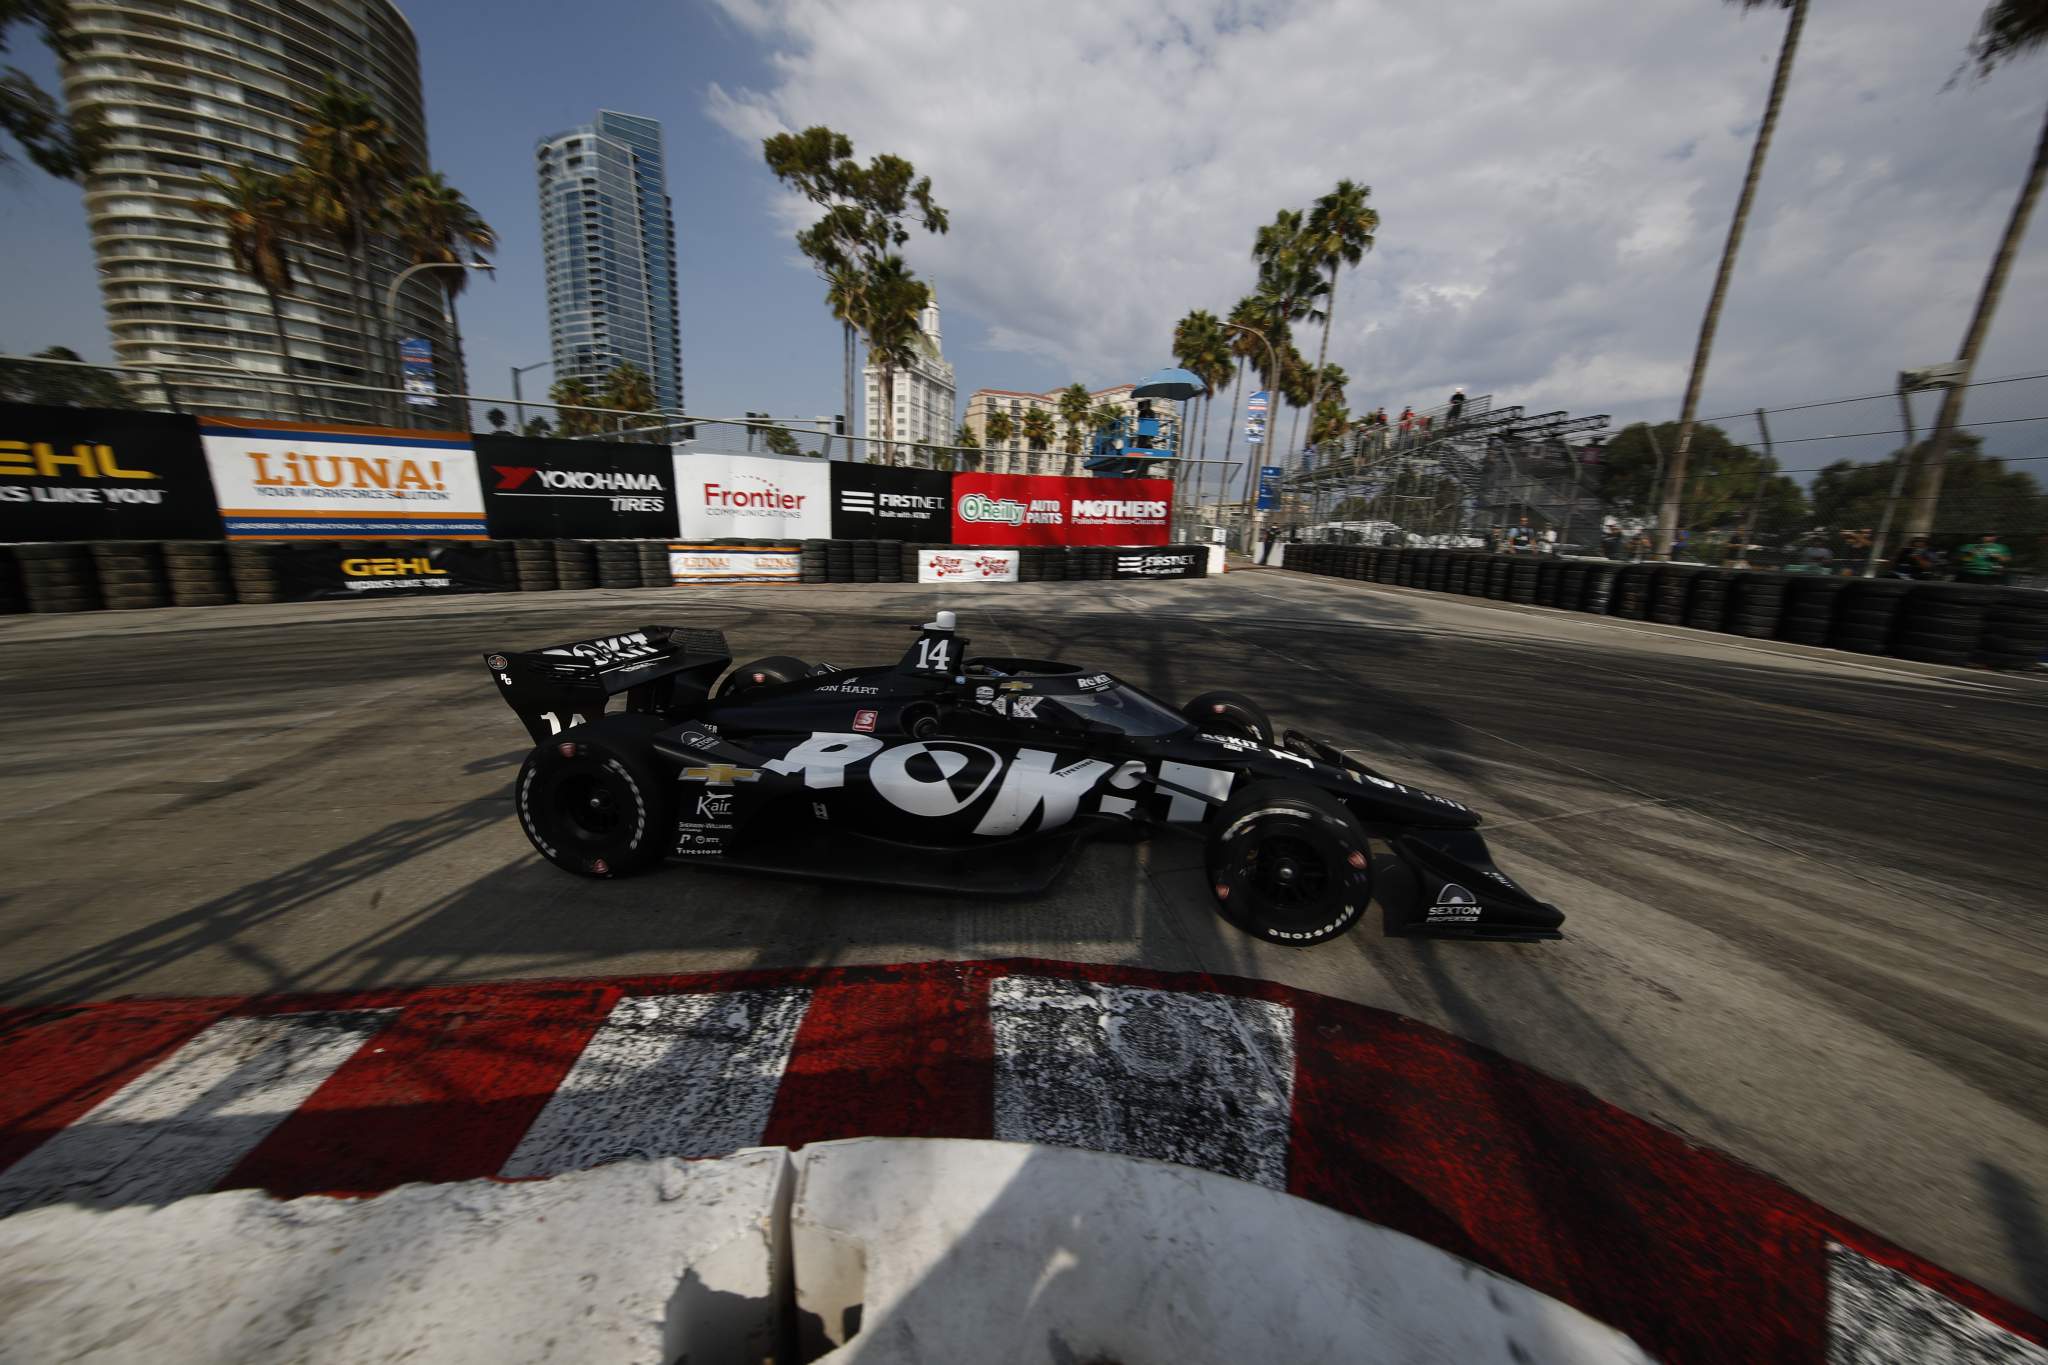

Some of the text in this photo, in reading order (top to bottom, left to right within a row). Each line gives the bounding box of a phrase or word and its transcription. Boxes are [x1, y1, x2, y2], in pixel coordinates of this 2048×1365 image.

[536, 470, 663, 491] YOKOHAMA
[31, 486, 101, 504] LIKE
[100, 488, 162, 504] YOU
[254, 486, 297, 497] YOUR
[302, 488, 386, 499] WORKFORCE
[704, 483, 807, 510] Frontier
[610, 499, 664, 512] TIRES
[1031, 500, 1060, 512] AUTO
[1072, 500, 1167, 518] MOTHERS
[1027, 512, 1063, 524] PARTS
[341, 558, 448, 576] GEHL
[915, 638, 951, 671] 14
[840, 685, 880, 695] HART
[1428, 906, 1483, 916] SEXTON
